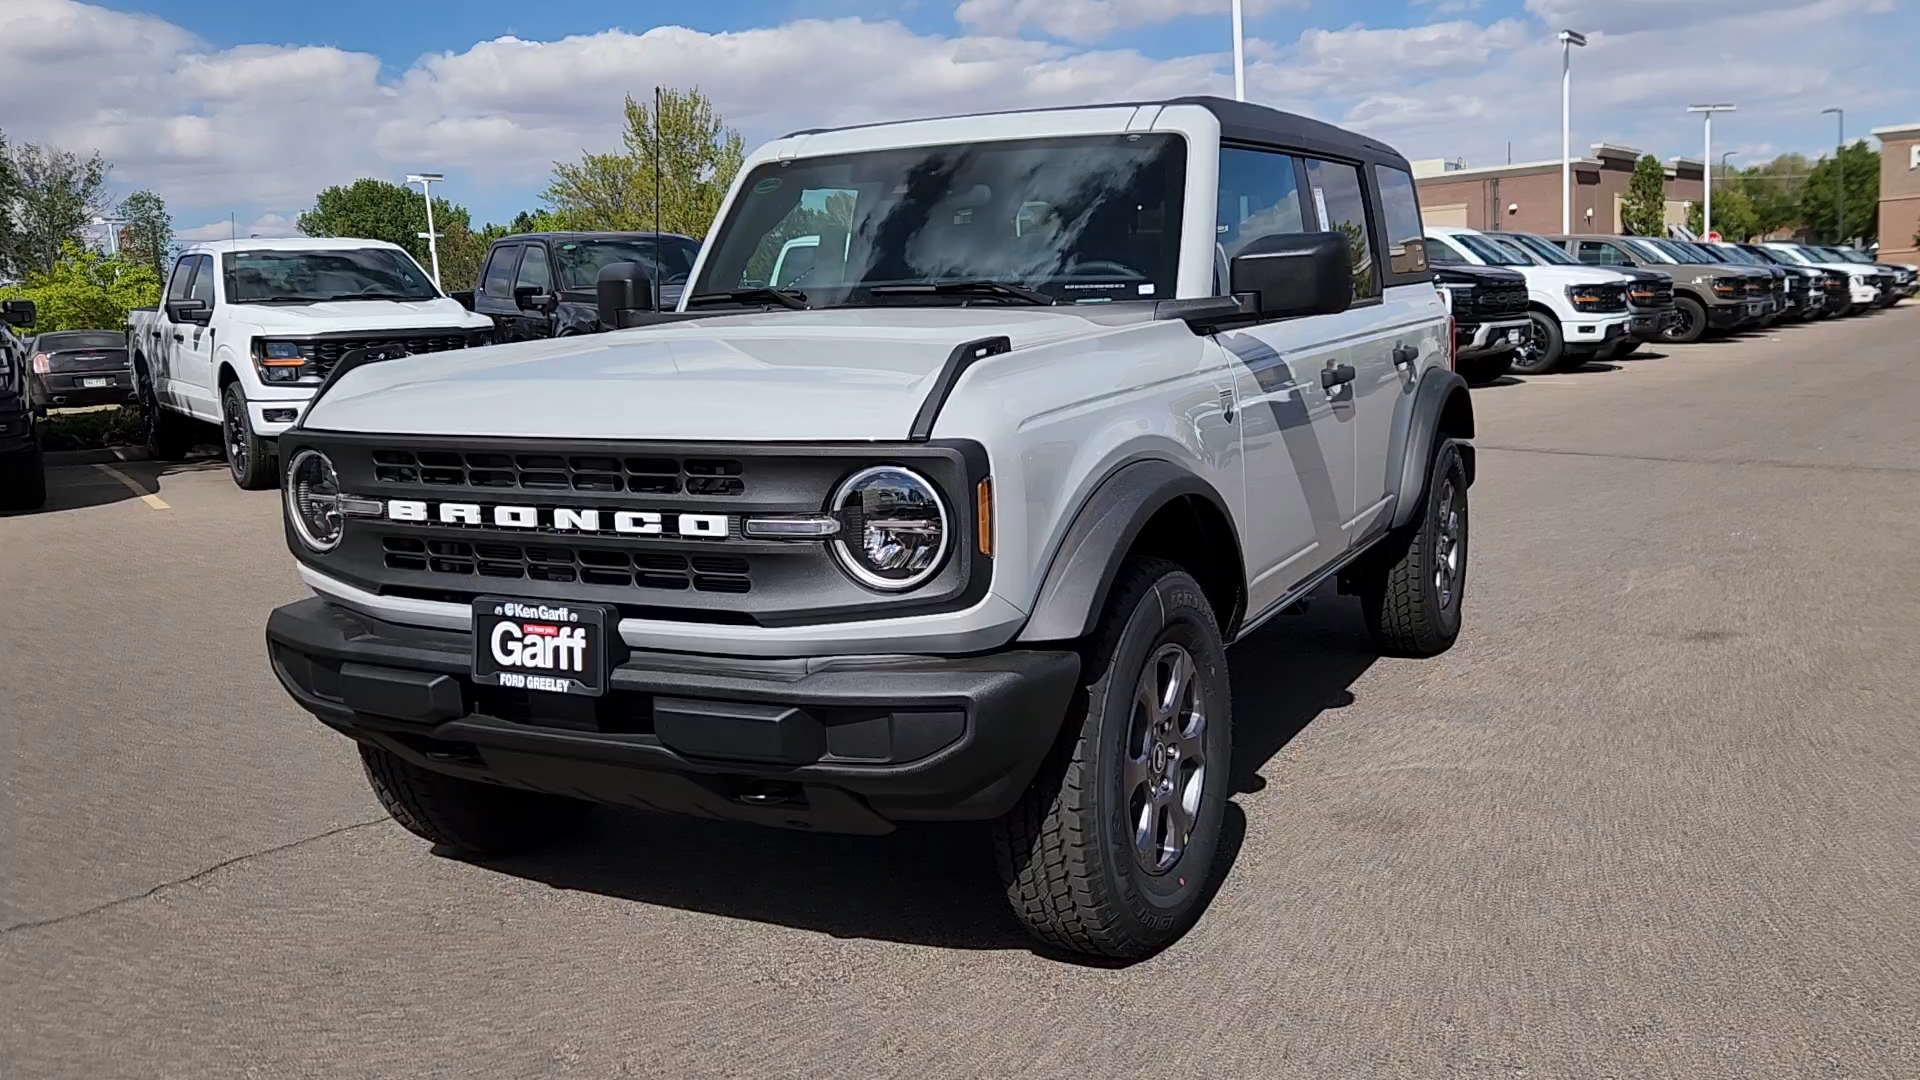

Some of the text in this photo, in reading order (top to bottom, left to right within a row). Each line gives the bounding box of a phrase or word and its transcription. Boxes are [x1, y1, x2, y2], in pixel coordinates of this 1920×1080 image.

[388, 500, 729, 537] BRONCO
[491, 620, 586, 672] Garff
[500, 673, 569, 692] FORD GREELEY
